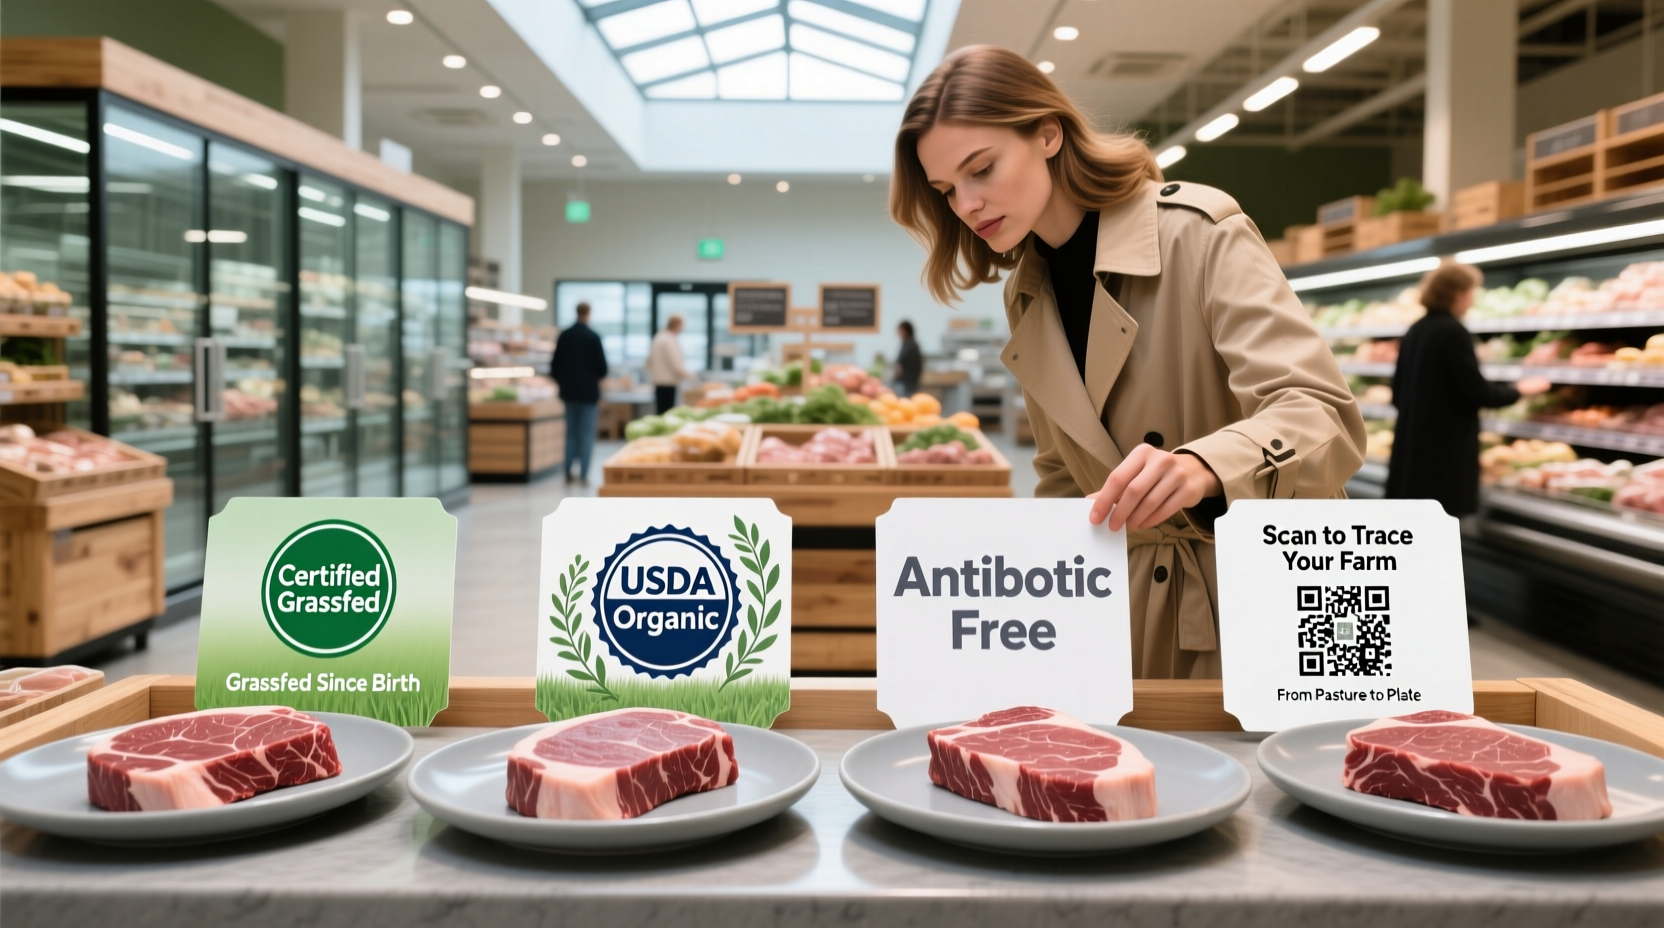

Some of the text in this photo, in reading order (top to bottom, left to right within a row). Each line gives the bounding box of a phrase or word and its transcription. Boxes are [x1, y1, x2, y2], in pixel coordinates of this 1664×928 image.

[1262, 524, 1413, 545] Scan to Trace
[1282, 551, 1397, 571] Your Farm
[278, 563, 381, 587] Certified
[620, 565, 716, 596] USDA
[893, 554, 1112, 598] Antibotic
[277, 590, 381, 613] Grassfed
[613, 604, 719, 637] Organic
[951, 609, 1057, 651] Free
[225, 672, 421, 692] Grassfed Since Birth
[1277, 687, 1422, 701] From Pasture to Plate
